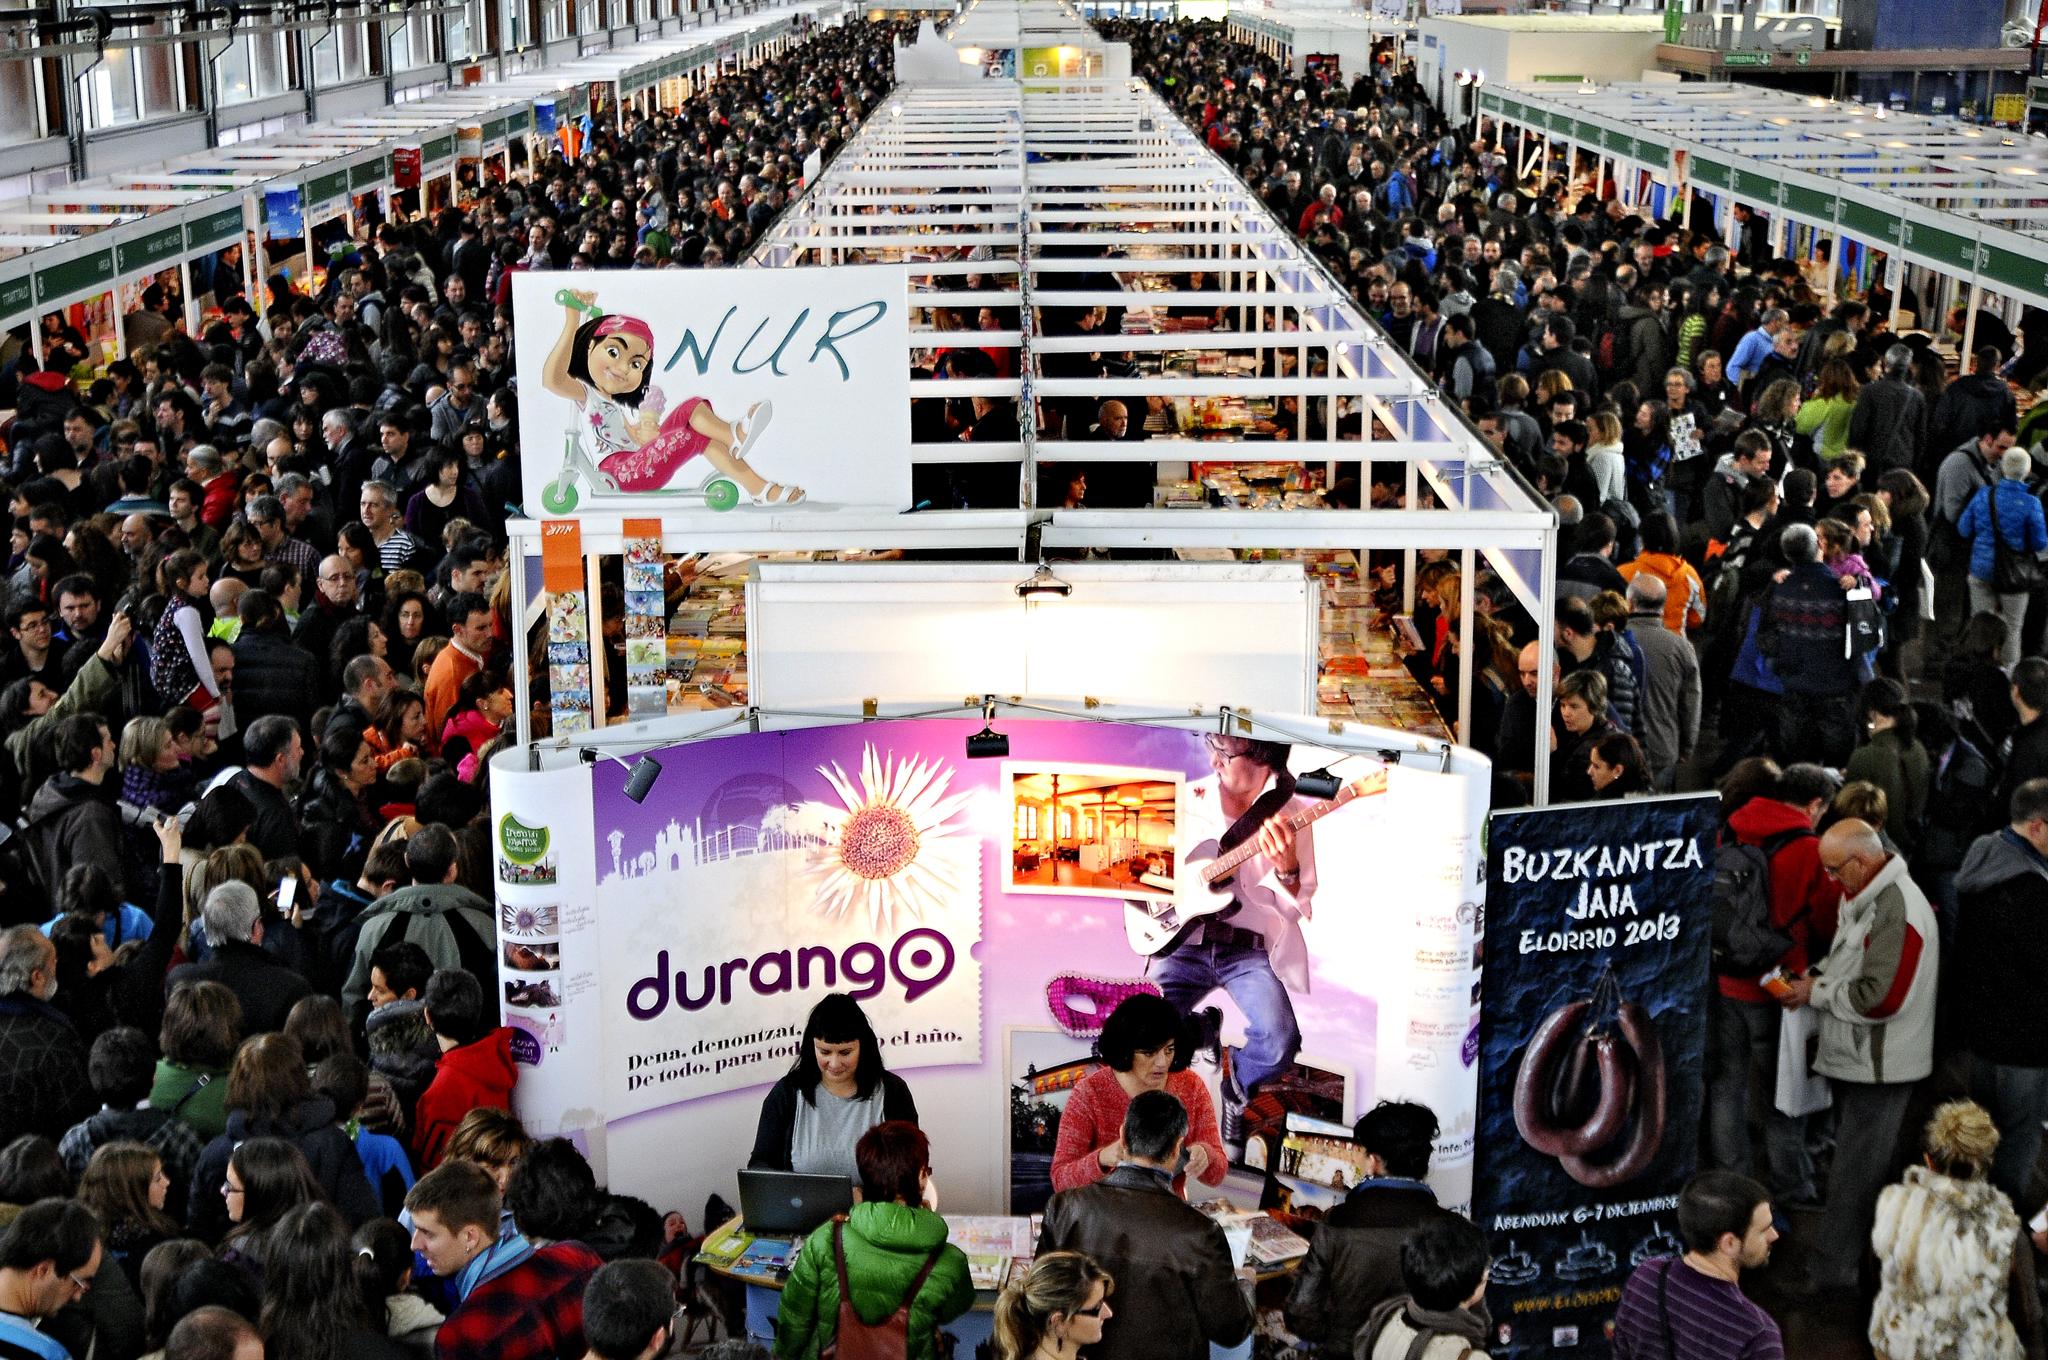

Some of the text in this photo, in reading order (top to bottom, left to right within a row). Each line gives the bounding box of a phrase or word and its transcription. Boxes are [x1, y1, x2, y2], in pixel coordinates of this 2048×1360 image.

[662, 300, 889, 383] NUR
[1502, 837, 1704, 883] BUZKANTZA
[1565, 881, 1639, 920] JAIA
[1518, 912, 1681, 955] ELORRIO 2013
[625, 926, 956, 1022] durango
[627, 1075, 655, 1092] De
[714, 1051, 763, 1075] para
[890, 1030, 910, 1047] el
[1493, 1210, 1570, 1232] ABENDUAK
[1605, 1193, 1680, 1219] DICIEMBRE
